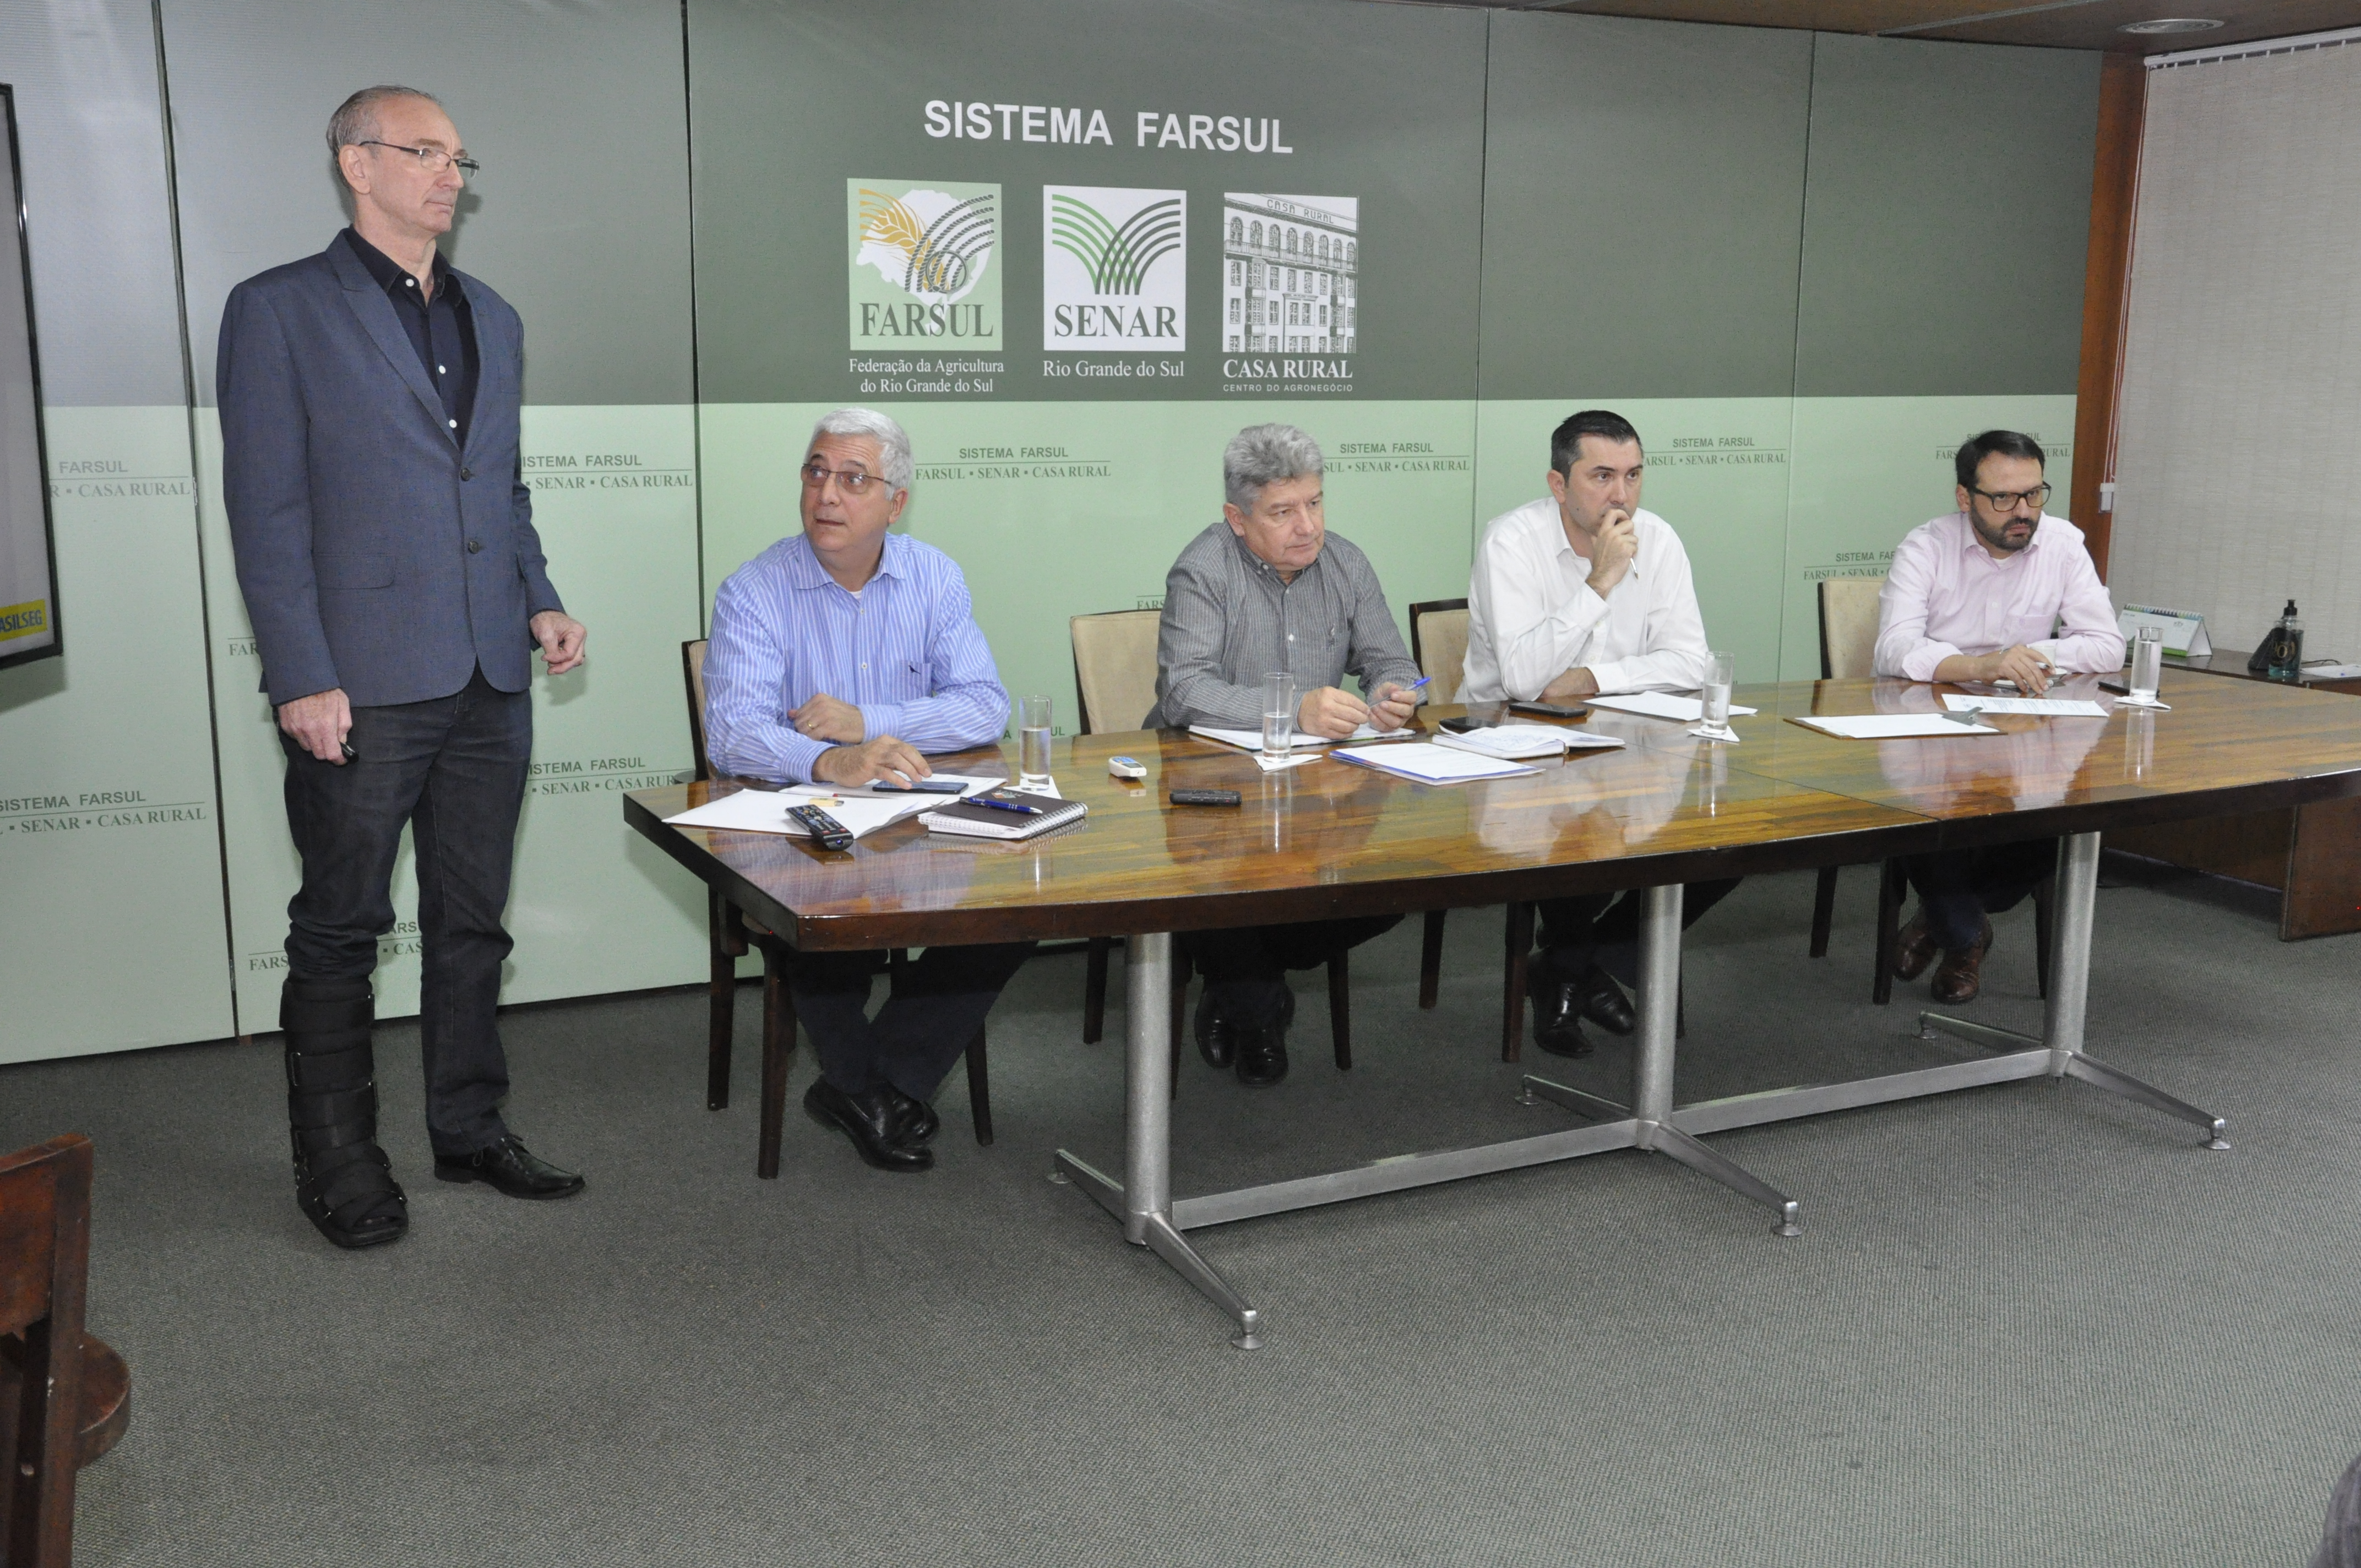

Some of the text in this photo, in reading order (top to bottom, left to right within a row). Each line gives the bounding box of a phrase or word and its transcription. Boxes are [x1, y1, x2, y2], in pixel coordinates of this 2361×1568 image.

[924, 100, 1293, 154] SISTEMA FARSUL
[1266, 199, 1334, 224] CASA RURAL
[859, 303, 993, 337] FARSUL
[1054, 304, 1179, 337] SENAR
[849, 358, 1004, 375] Federação da Agricultura
[1043, 360, 1184, 377] Rio Grande do Sul
[1223, 359, 1353, 378] CASA RURAL
[860, 378, 993, 393] do Rio Grande do Sul
[1283, 383, 1353, 392] AGRONEGÓCIO
[1340, 443, 1434, 454] SISTEMA FARSUL
[1673, 437, 1755, 448] SISTEMA FARSUL
[959, 447, 1069, 459] SISTEMA FARSUL
[1644, 453, 1786, 466] ARSUL SENAR CASA RURAL
[59, 460, 128, 474] FARSUL
[523, 455, 642, 467] ISTEMA FARSUL
[1324, 460, 1470, 472] SUL SENAR CASA RURAL
[915, 465, 1111, 480] FARSUL SENAR CASA RURAL
[78, 482, 191, 497] CASA RURAL
[535, 475, 693, 489] SENAR CASA RURAL
[1836, 552, 1875, 562] SISTEMA
[529, 757, 645, 775] ISTEMA FARSUL
[542, 781, 590, 795] SENAR
[605, 776, 643, 790] CASA
[646, 775, 675, 787] RUR
[80, 791, 146, 805] FARSUL
[21, 808, 206, 833] SENAR CASA RURAL
[393, 941, 423, 955] CAS
[249, 955, 289, 971] FARS
